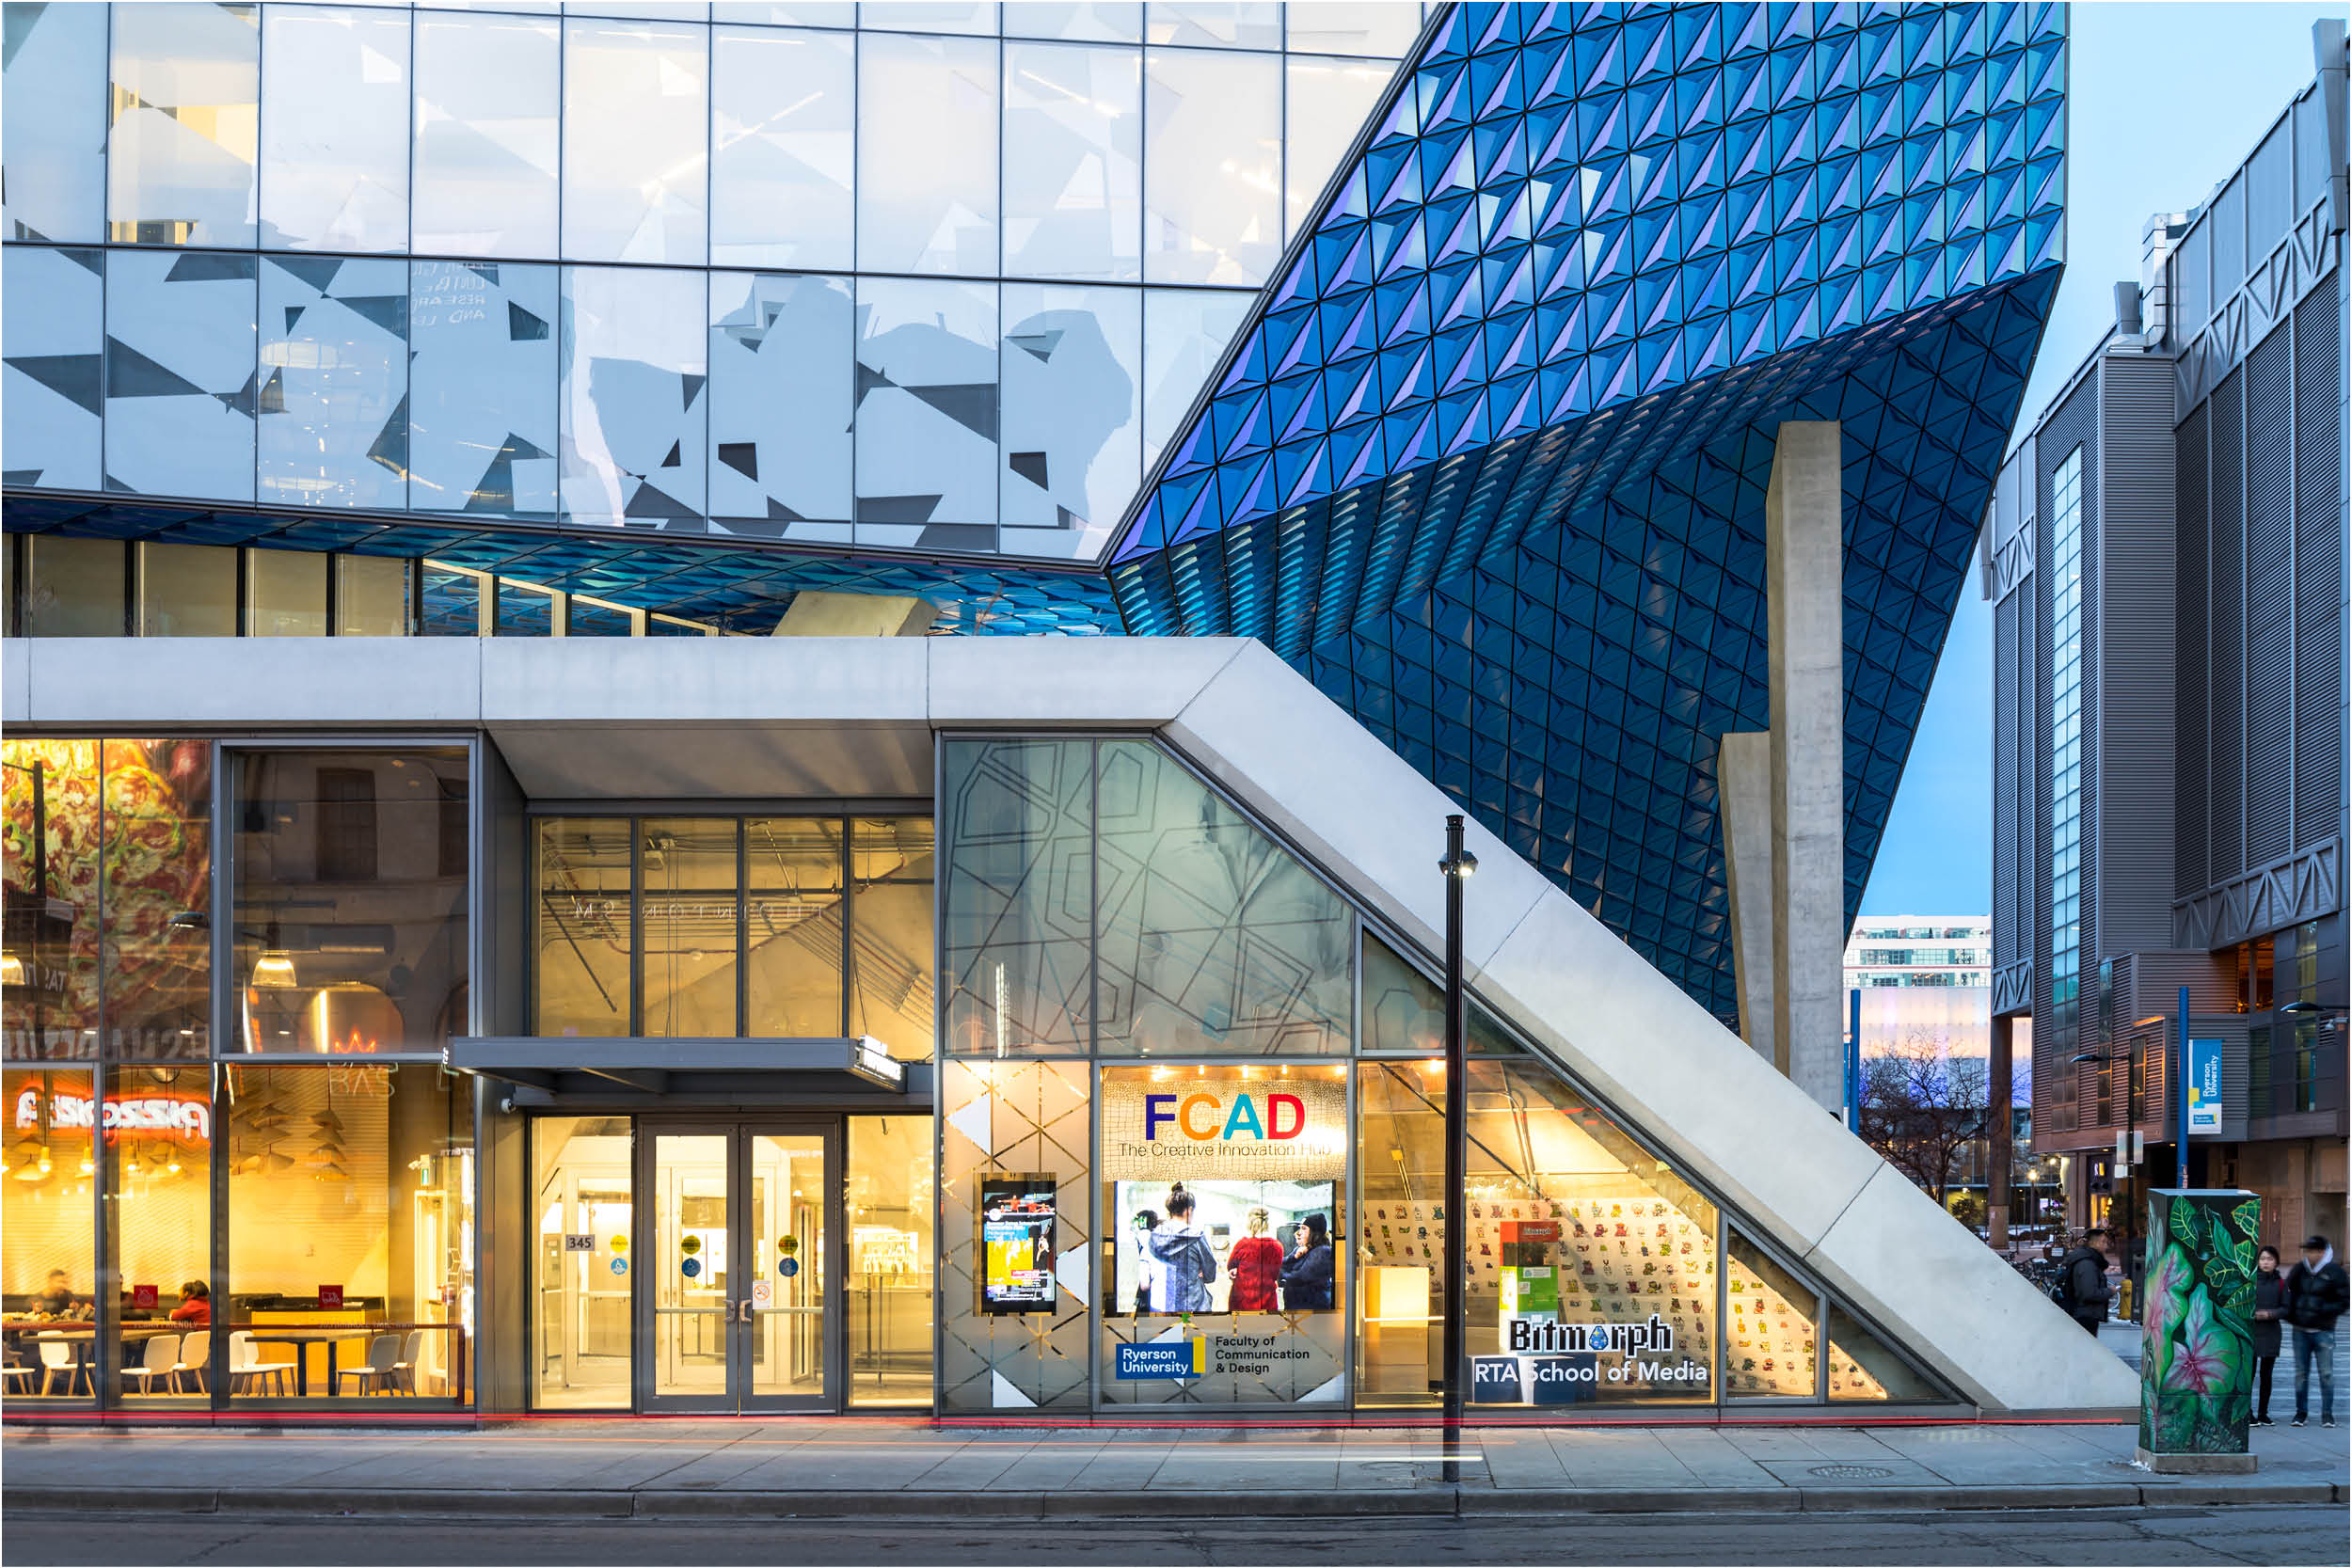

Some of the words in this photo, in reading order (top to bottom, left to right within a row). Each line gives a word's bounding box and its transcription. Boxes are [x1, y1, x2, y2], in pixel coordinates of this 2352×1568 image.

[2202, 1063, 2211, 1097] Ryerson
[1145, 1093, 1306, 1141] FCAD
[1120, 1143, 1147, 1157] The
[1152, 1143, 1214, 1157] Creative
[1219, 1143, 1295, 1157] Innovation
[1301, 1143, 1331, 1157] Hub
[569, 1237, 592, 1249] 345
[1216, 1336, 1260, 1349] Faculty
[1263, 1336, 1276, 1346] of
[1122, 1348, 1176, 1362] Ryerson
[1216, 1349, 1310, 1360] Communication
[1122, 1361, 1189, 1375] University
[1216, 1362, 1226, 1373] &
[1229, 1362, 1270, 1375] Design
[1474, 1363, 1519, 1383] RTA
[1528, 1361, 1599, 1383] School
[1607, 1361, 1636, 1383] of
[1638, 1361, 1708, 1383] Media
